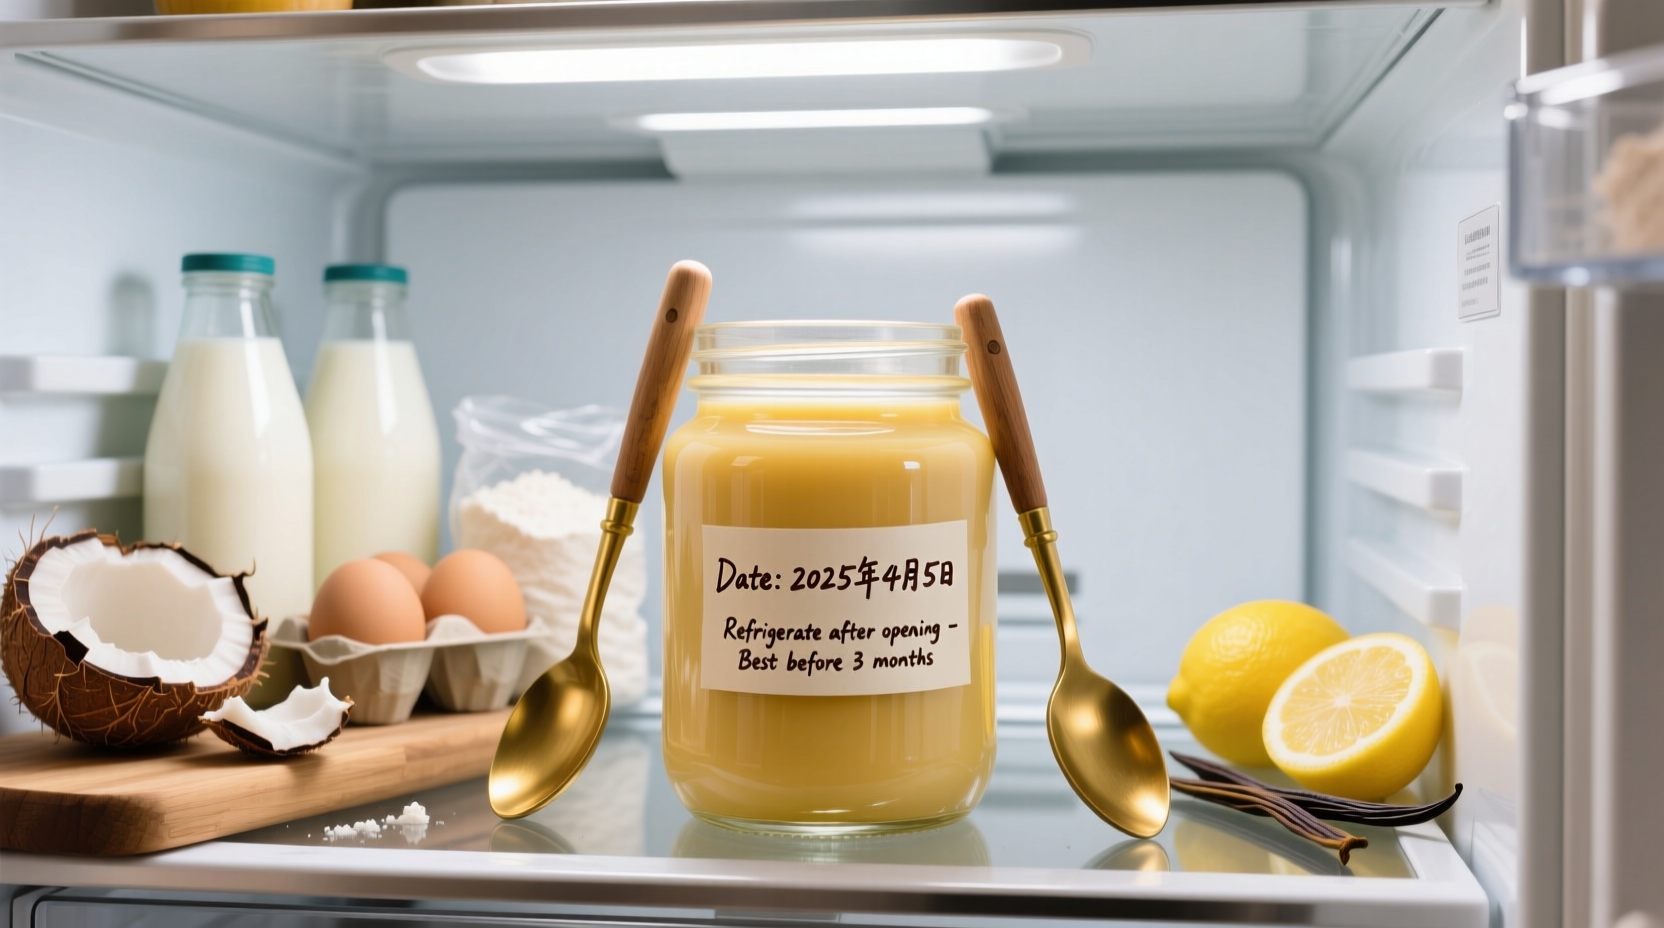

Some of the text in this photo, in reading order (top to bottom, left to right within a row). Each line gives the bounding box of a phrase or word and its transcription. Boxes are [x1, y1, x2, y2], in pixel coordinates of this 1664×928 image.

[715, 555, 954, 600] Date: 2025年4月5日
[723, 616, 822, 650] Refrigerate
[828, 619, 876, 645] after
[881, 619, 941, 647] opening
[737, 646, 934, 678] Best before 3 months
